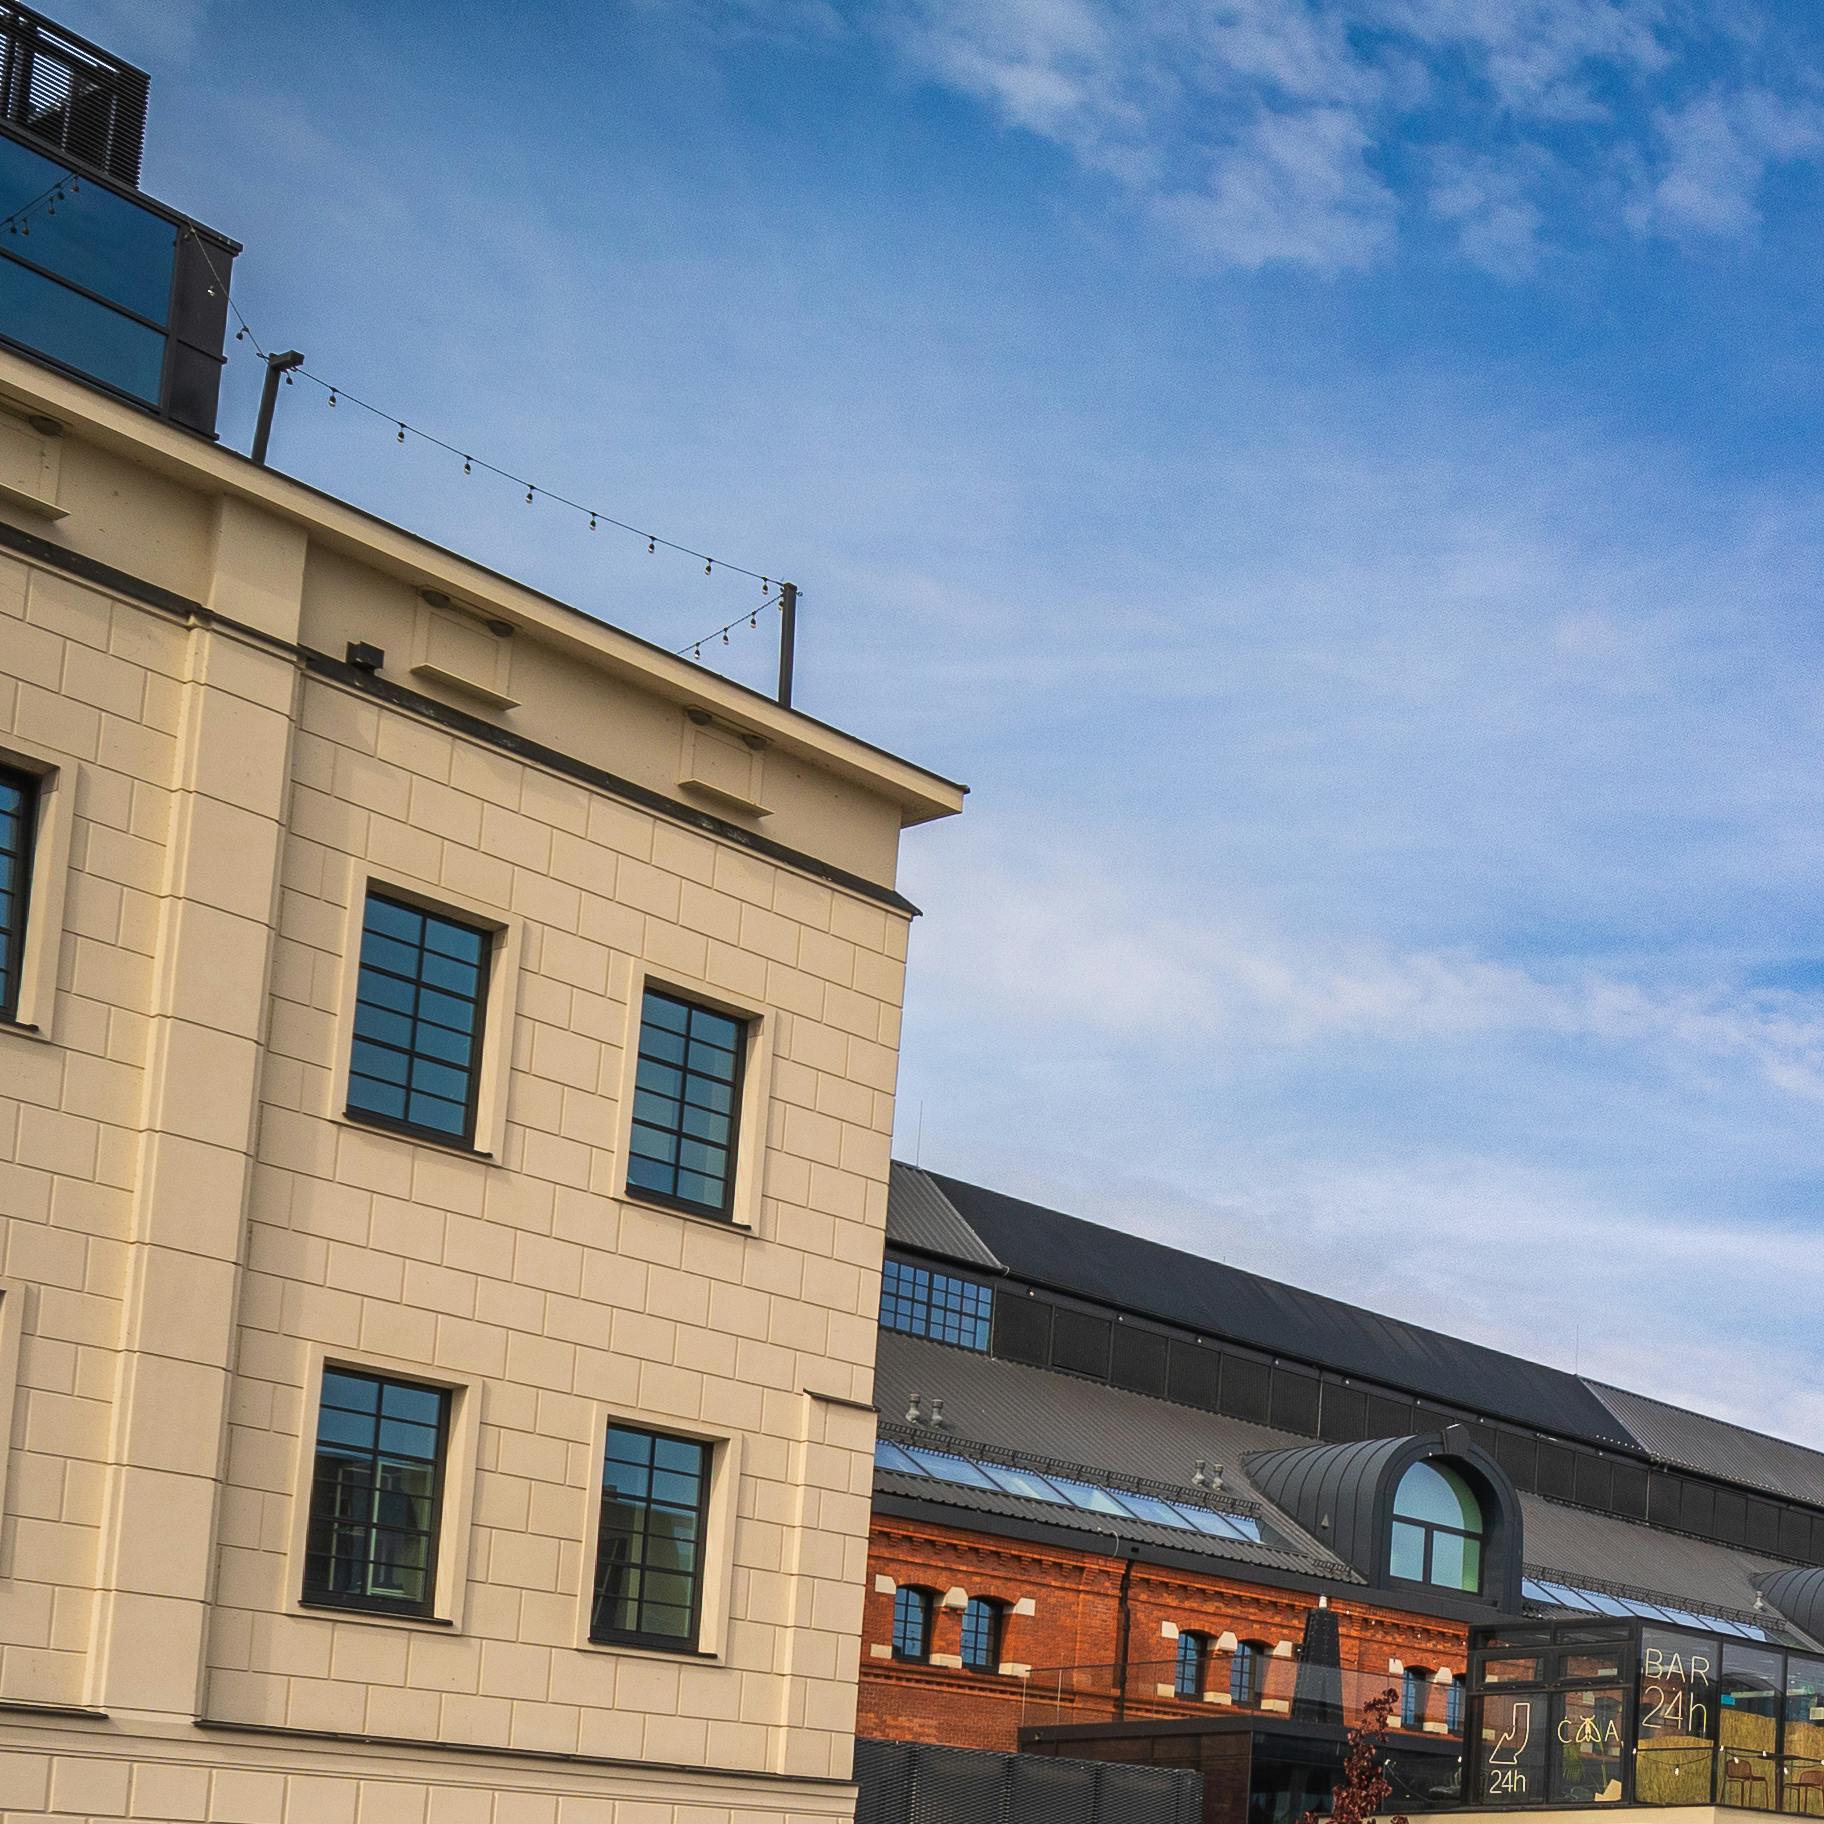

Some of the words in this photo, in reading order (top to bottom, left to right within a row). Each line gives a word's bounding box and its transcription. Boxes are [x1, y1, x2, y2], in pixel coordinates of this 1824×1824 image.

[1645, 1648, 1710, 1687] BAR
[1642, 1686, 1708, 1734] 24h
[1490, 1769, 1526, 1794] 24h
